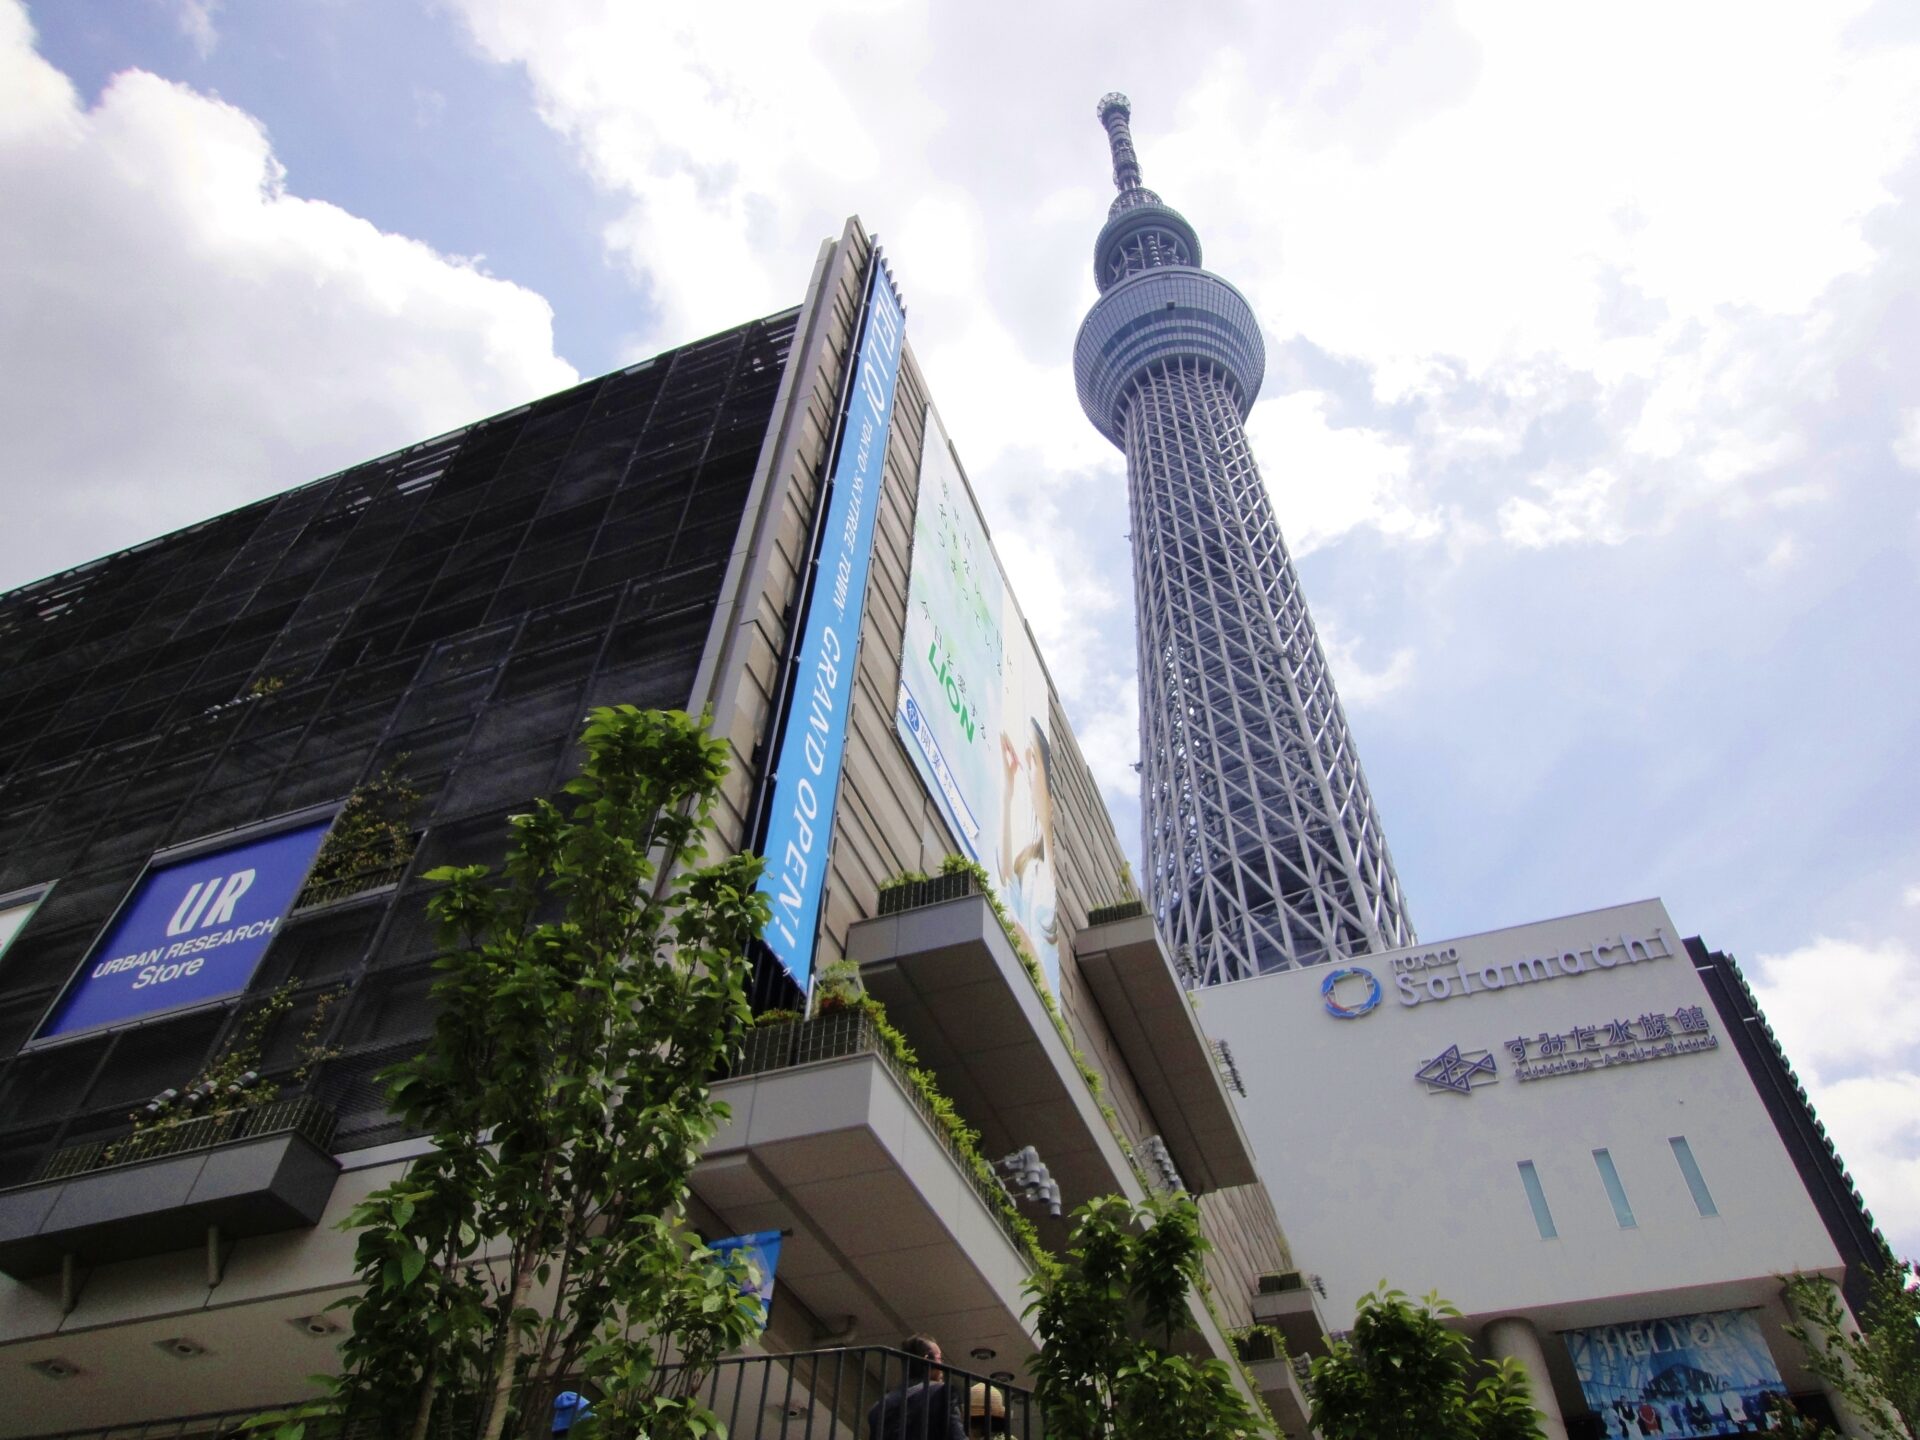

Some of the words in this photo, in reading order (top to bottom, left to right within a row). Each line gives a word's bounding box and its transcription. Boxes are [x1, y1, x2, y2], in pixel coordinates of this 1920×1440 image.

[861, 278, 901, 427] HELLO!
[858, 415, 873, 473] TOKYO
[844, 469, 864, 555] SKYTREE
[805, 626, 841, 775] GRAND
[928, 641, 975, 744] LION
[774, 778, 818, 948] OPEN!
[166, 868, 256, 937] UR
[93, 948, 164, 978] URBAN
[166, 917, 279, 959] RESEARCH
[132, 957, 205, 990] Store
[1389, 946, 1461, 972] TOKYO
[1504, 1005, 1710, 1062] すみだ水族館
[1515, 1058, 1595, 1082] SUMIDA
[1603, 1034, 1719, 1065] AQUARIUM
